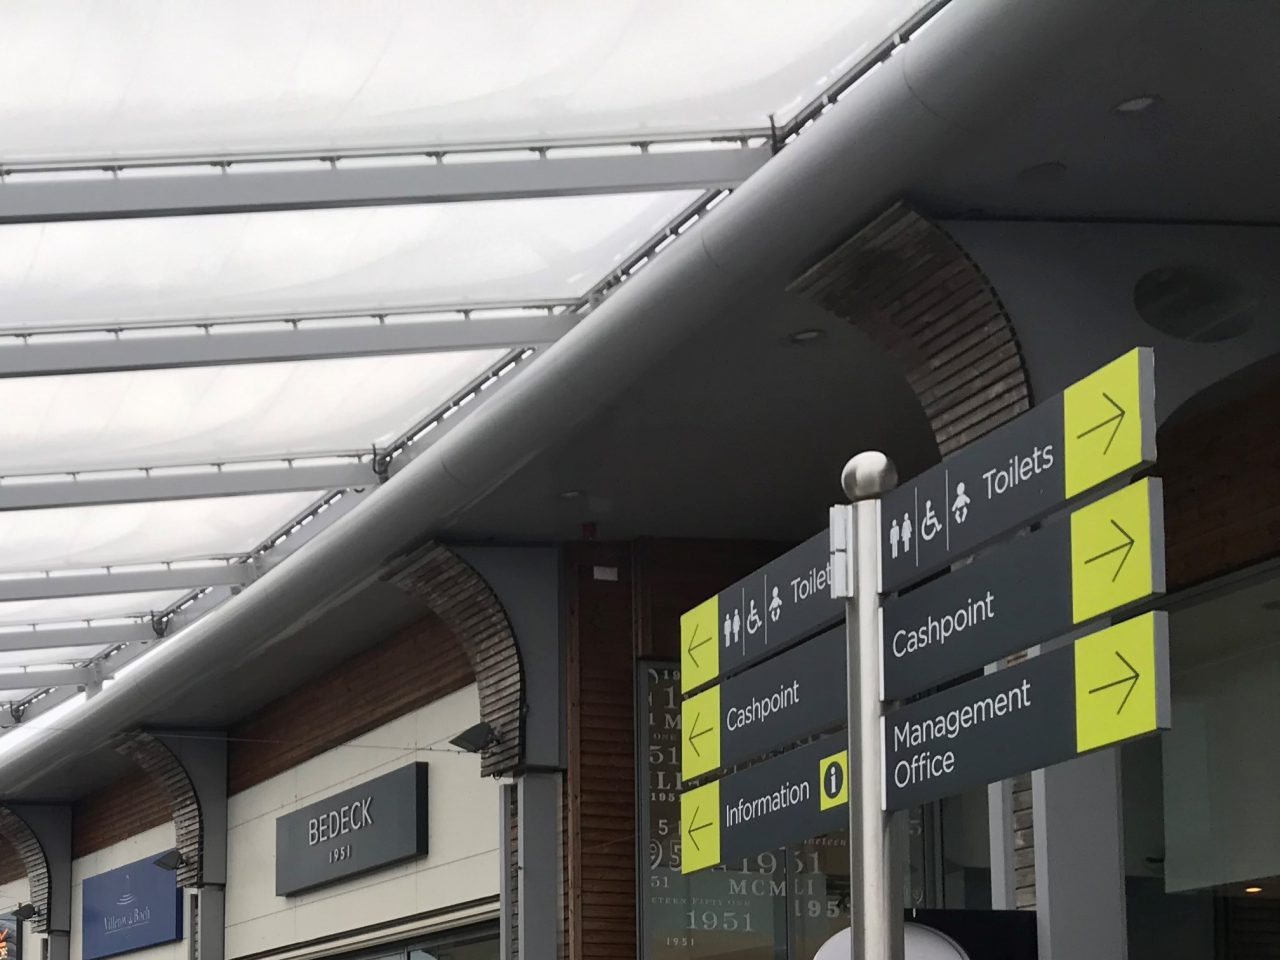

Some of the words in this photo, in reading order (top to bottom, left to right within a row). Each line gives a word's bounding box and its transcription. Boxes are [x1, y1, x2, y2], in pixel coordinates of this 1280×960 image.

[982, 443, 1055, 500] Toilets
[791, 561, 832, 603] Toilet
[892, 591, 995, 658] Cashpoint
[726, 680, 800, 732] Cashpoint
[893, 679, 1032, 752] Management
[893, 750, 956, 789] Office
[308, 796, 374, 846] BEDECK
[725, 780, 811, 828] Information
[328, 845, 353, 863] 1951
[133, 906, 151, 923] Boch
[686, 909, 754, 932] 1951
[665, 937, 695, 947] 1951
